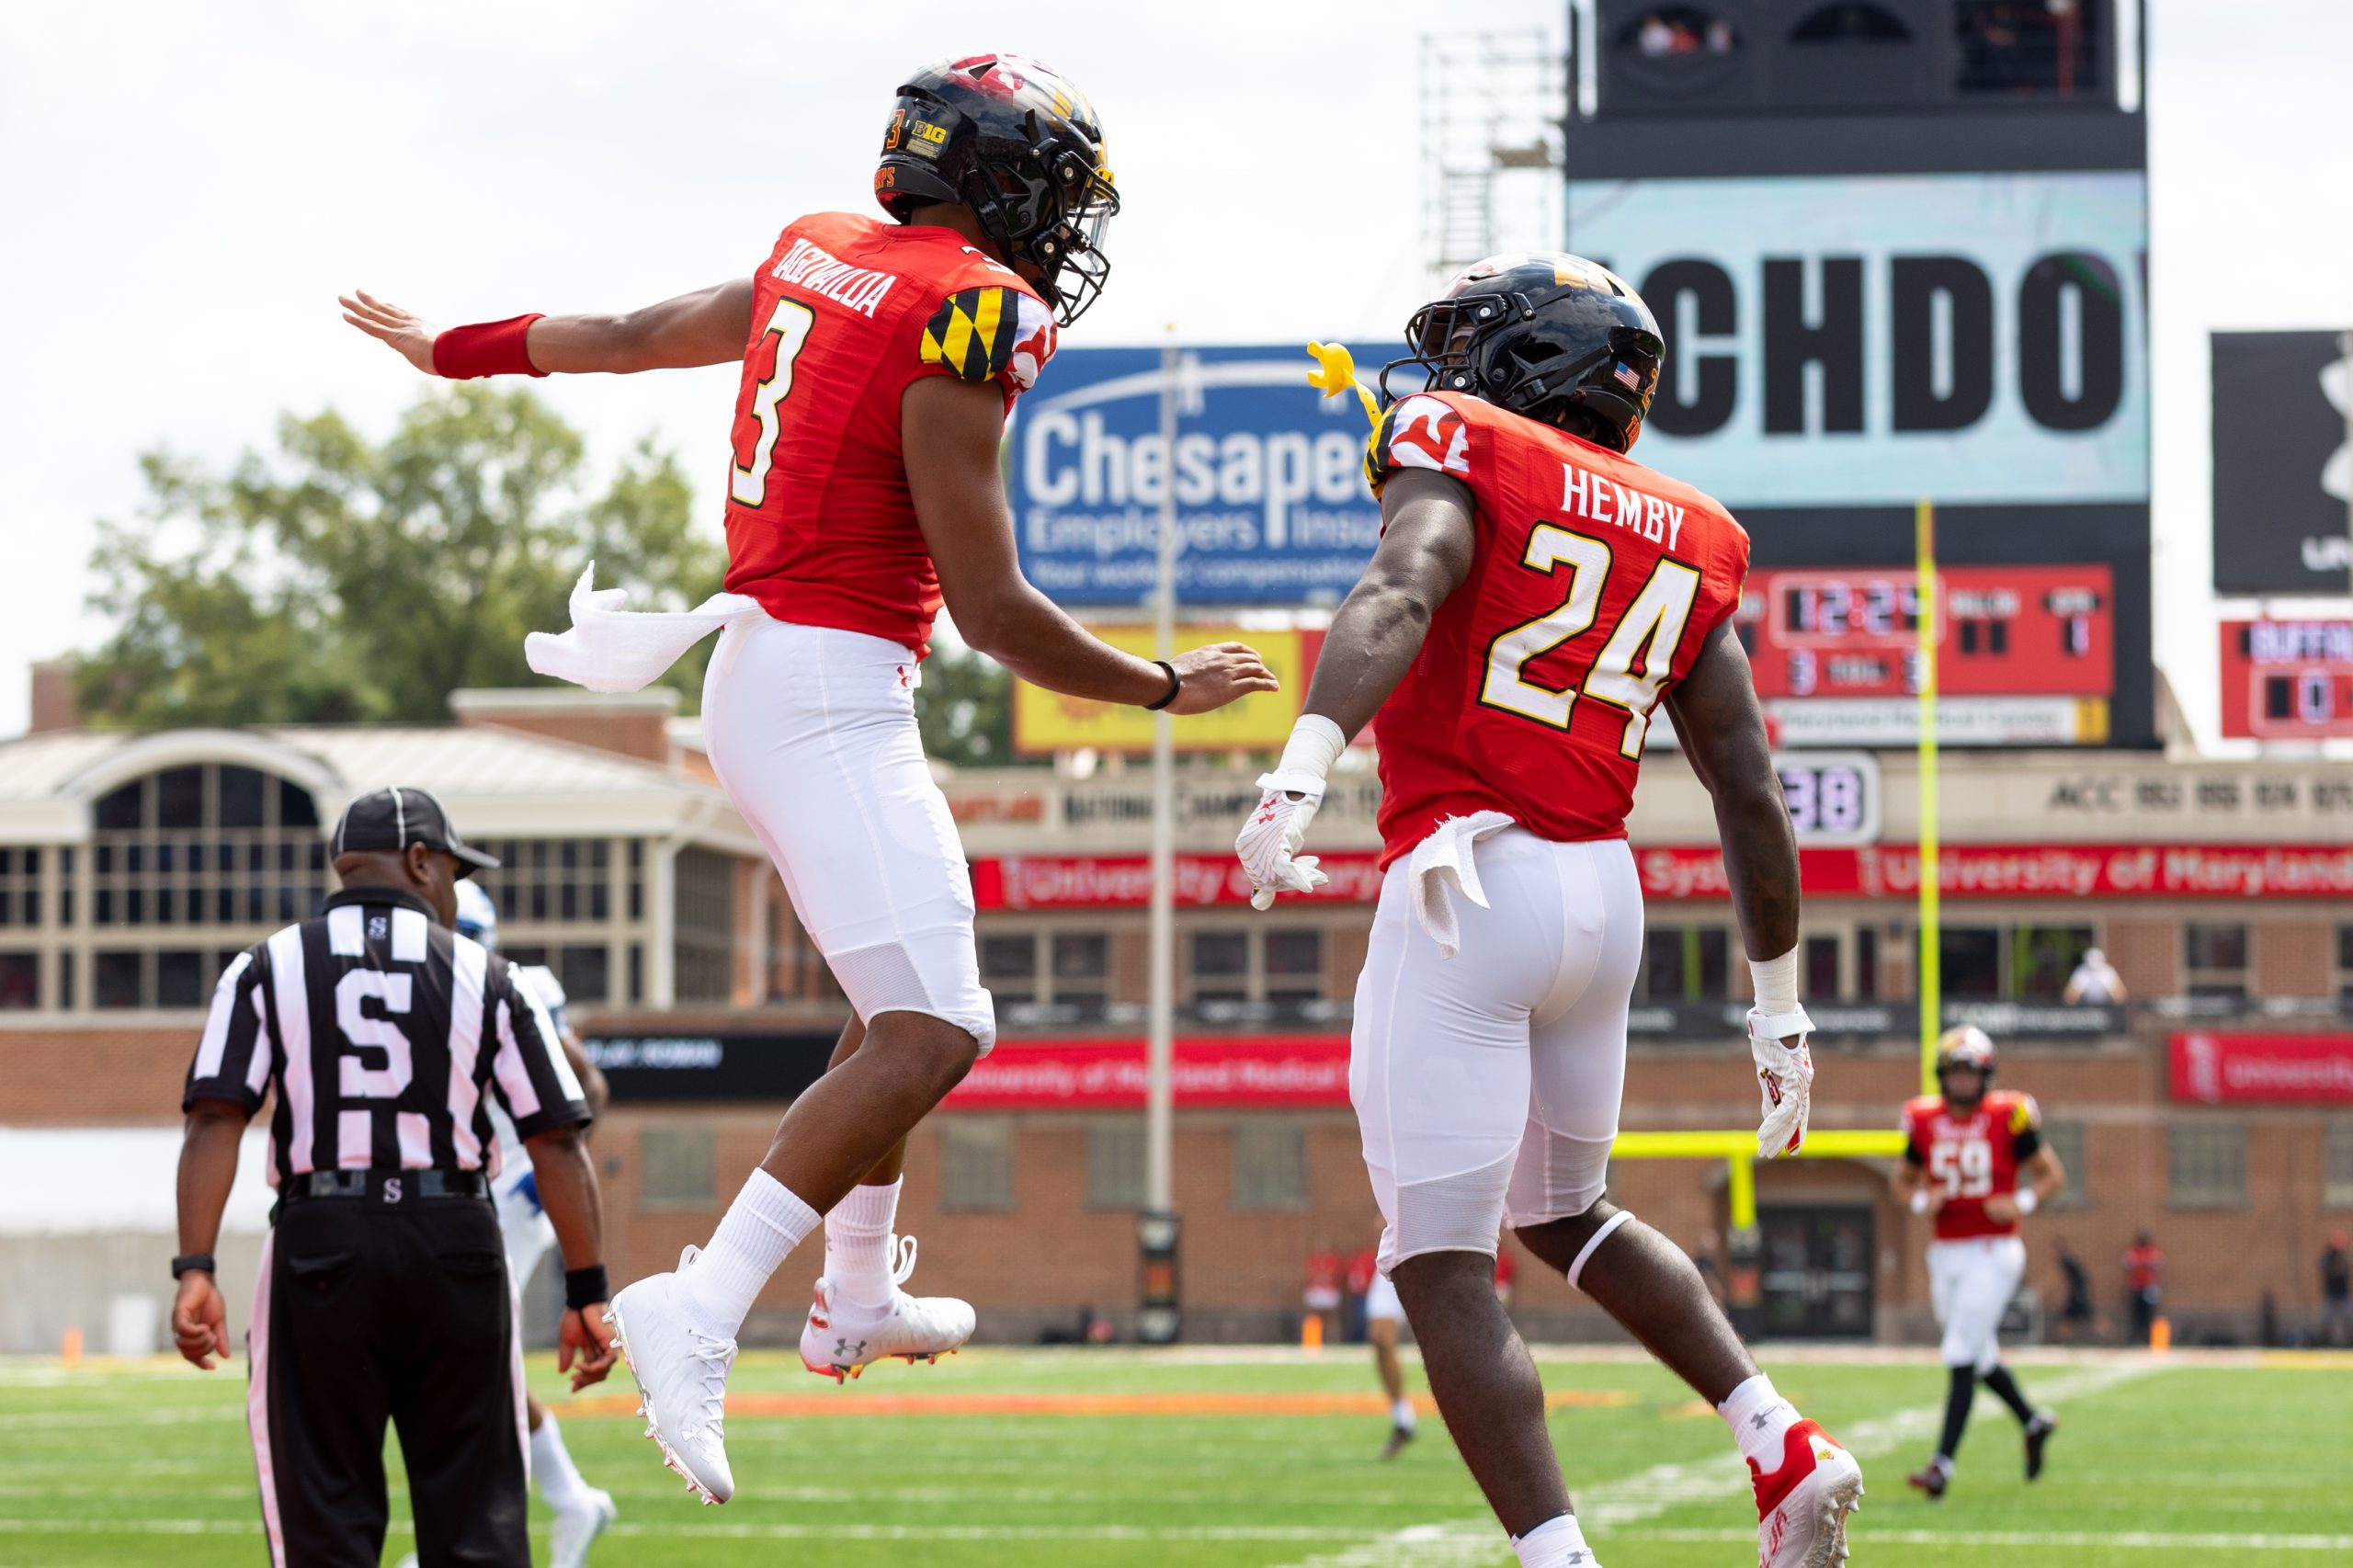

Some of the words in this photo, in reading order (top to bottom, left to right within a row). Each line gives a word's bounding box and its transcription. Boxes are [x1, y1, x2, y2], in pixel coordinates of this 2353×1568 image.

[886, 108, 905, 149] 3
[772, 238, 897, 319] TAGOVAILOA
[1597, 252, 2149, 439] CHDO
[731, 295, 816, 509] 3
[1561, 463, 1684, 551] HEMBY
[1476, 519, 1702, 762] 24
[1789, 648, 1816, 696] 3
[2300, 668, 2334, 724] 0
[1781, 767, 1860, 831] 38
[2106, 847, 2156, 892] of
[335, 969, 413, 1097] S
[383, 1178, 403, 1202] S
[1930, 1140, 1993, 1199] 59
